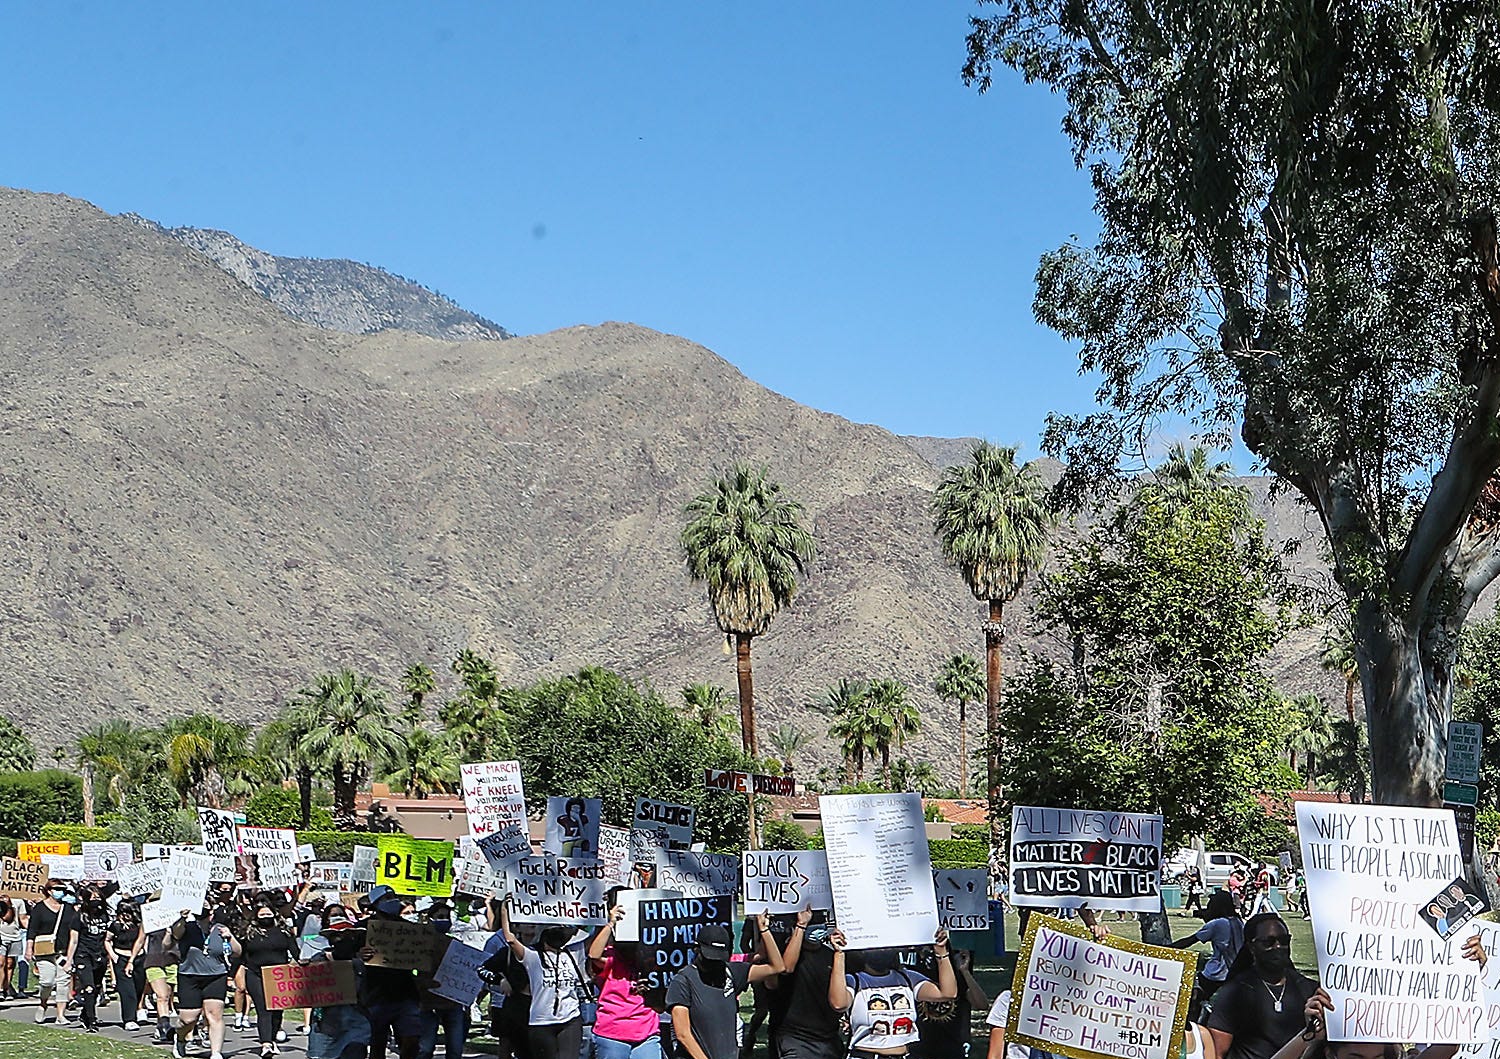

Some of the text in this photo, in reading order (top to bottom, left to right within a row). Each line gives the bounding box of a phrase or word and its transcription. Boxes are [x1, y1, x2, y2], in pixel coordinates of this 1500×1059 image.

[462, 763, 519, 775] WE MARCH
[704, 769, 748, 792] LOVE
[465, 785, 520, 797] WE KNEEL
[467, 804, 523, 814] WE SPEAK UP
[245, 829, 282, 839] WHITE
[472, 822, 494, 833] WE
[1013, 807, 1161, 842] ALL LIVES CAN'T
[1311, 813, 1450, 847] WHY IS IT THAT
[26, 845, 59, 854] POLICE
[282, 840, 292, 849] IS
[1015, 843, 1155, 867] MATTER BLACK
[4, 859, 44, 875] BLACK
[384, 851, 447, 883] BLM
[519, 858, 555, 876] Fuck
[557, 858, 605, 879] Racists
[745, 854, 799, 878] BLACK
[1308, 842, 1463, 882] THE PEOPLE ASSIGNED
[1, 881, 46, 894] MATTER
[8, 872, 40, 882] LIVES
[353, 880, 376, 893] WHIT
[661, 870, 712, 884] Racist
[1022, 870, 1159, 895] LIVES MATTER
[1383, 882, 1397, 893] to
[514, 879, 587, 900] Me N My
[745, 881, 800, 905] LIVES
[644, 898, 718, 921] HANDS
[1350, 896, 1421, 930] PROTECT
[940, 915, 987, 928] ACISTS
[643, 926, 667, 945] UP
[1040, 929, 1167, 982] YOU CAN JAIL
[1326, 930, 1349, 957] US
[1353, 933, 1383, 961] ARE
[1391, 936, 1424, 965] WHO
[1431, 939, 1454, 965] WE
[1035, 957, 1177, 1005] REVOLUTIONARIES
[1325, 963, 1405, 997] CONSTANTLY
[1407, 970, 1441, 1000] HAVE
[1444, 974, 1460, 1001] TO
[1462, 974, 1478, 1002] BE
[1028, 974, 1167, 1019] BUT YOU CANT JAIL
[1030, 994, 1163, 1033] A REVOLUTION
[1343, 997, 1420, 1039] PROTECTED
[1425, 1003, 1483, 1041] FROM?
[1080, 1025, 1148, 1059] HAMPTON
[1118, 1030, 1162, 1047] #BLM
